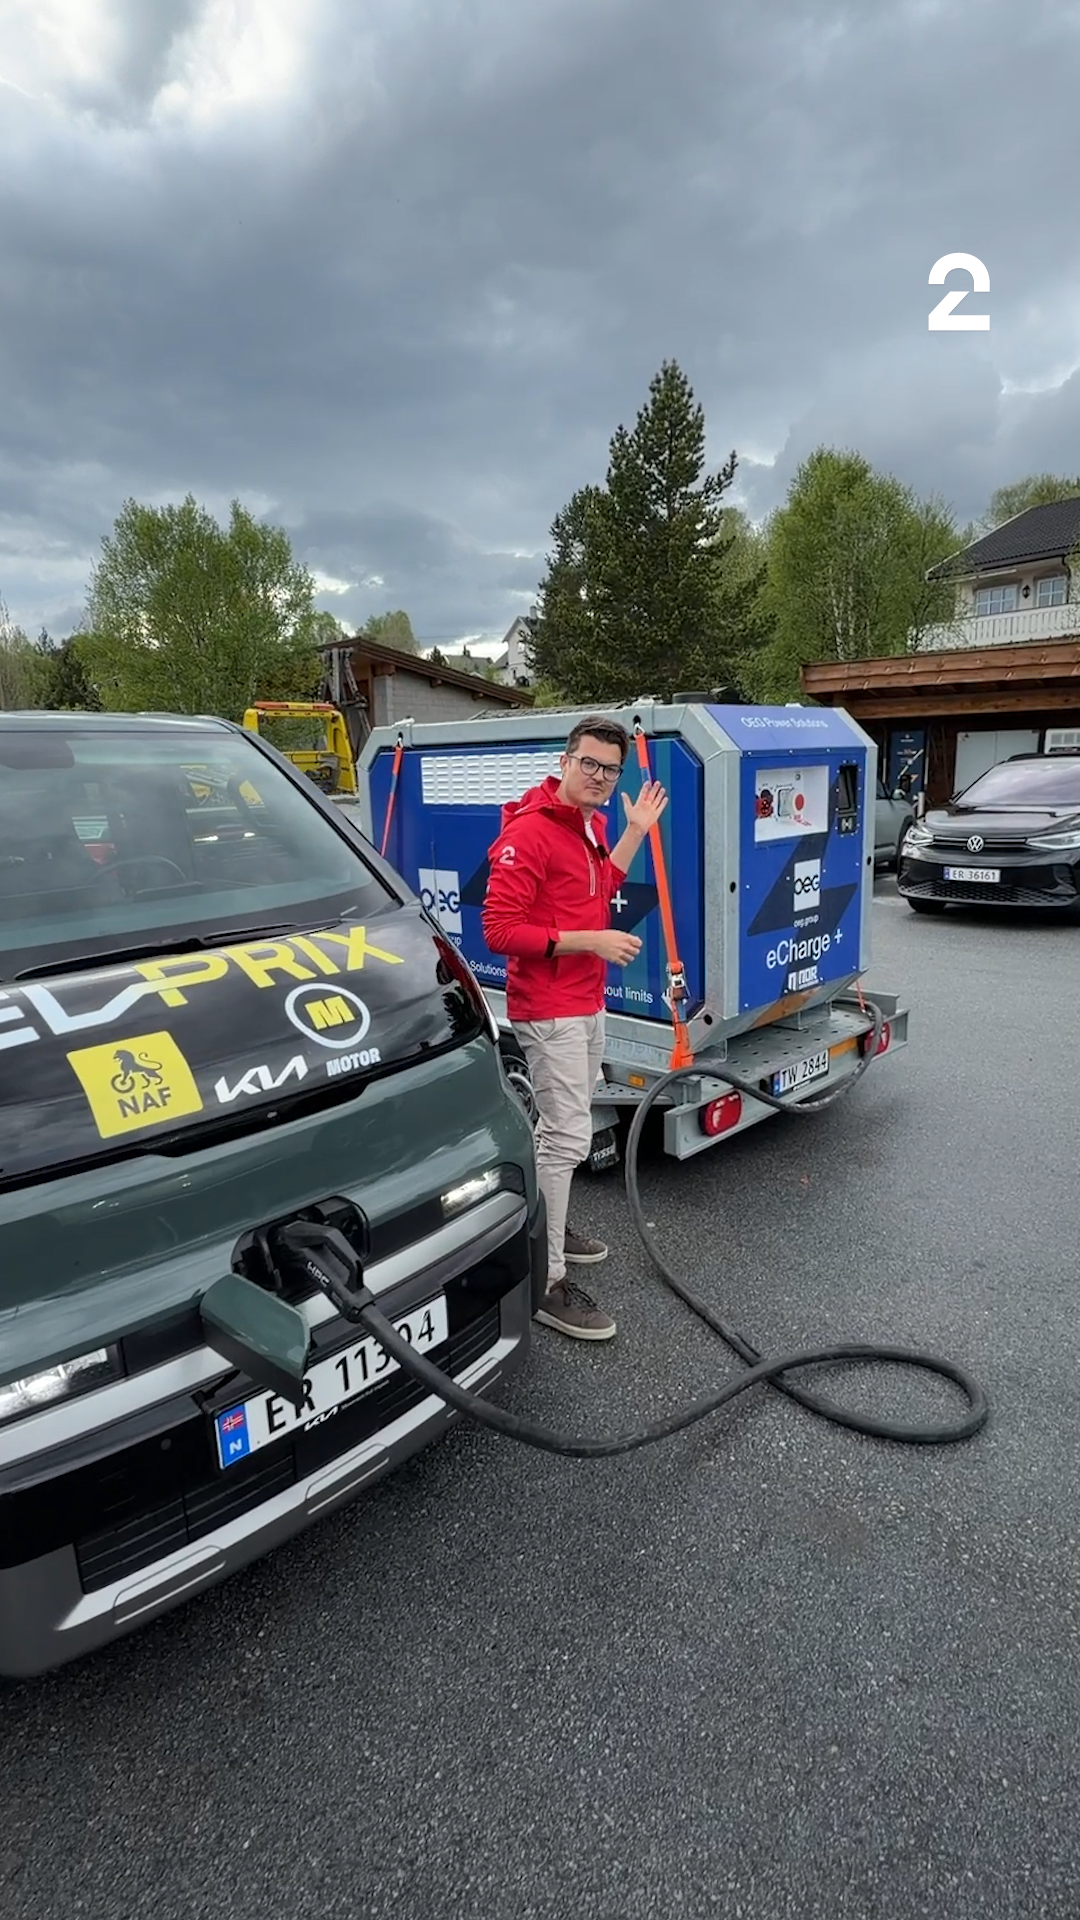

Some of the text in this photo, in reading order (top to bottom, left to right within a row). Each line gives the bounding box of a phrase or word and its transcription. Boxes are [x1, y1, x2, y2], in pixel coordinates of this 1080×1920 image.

[763, 717, 791, 728] Power
[789, 717, 828, 728] Solutions
[499, 846, 516, 866] 2
[953, 871, 996, 880] ER 36161
[766, 933, 831, 969] eCharge
[469, 960, 508, 977] Solutions
[625, 986, 653, 1003] limits
[304, 995, 356, 1030] M
[326, 1047, 381, 1077] MOTOR
[782, 1065, 798, 1088] TW
[802, 1051, 827, 1078] 2844
[117, 1087, 172, 1118] NAF
[229, 1439, 243, 1454] N
